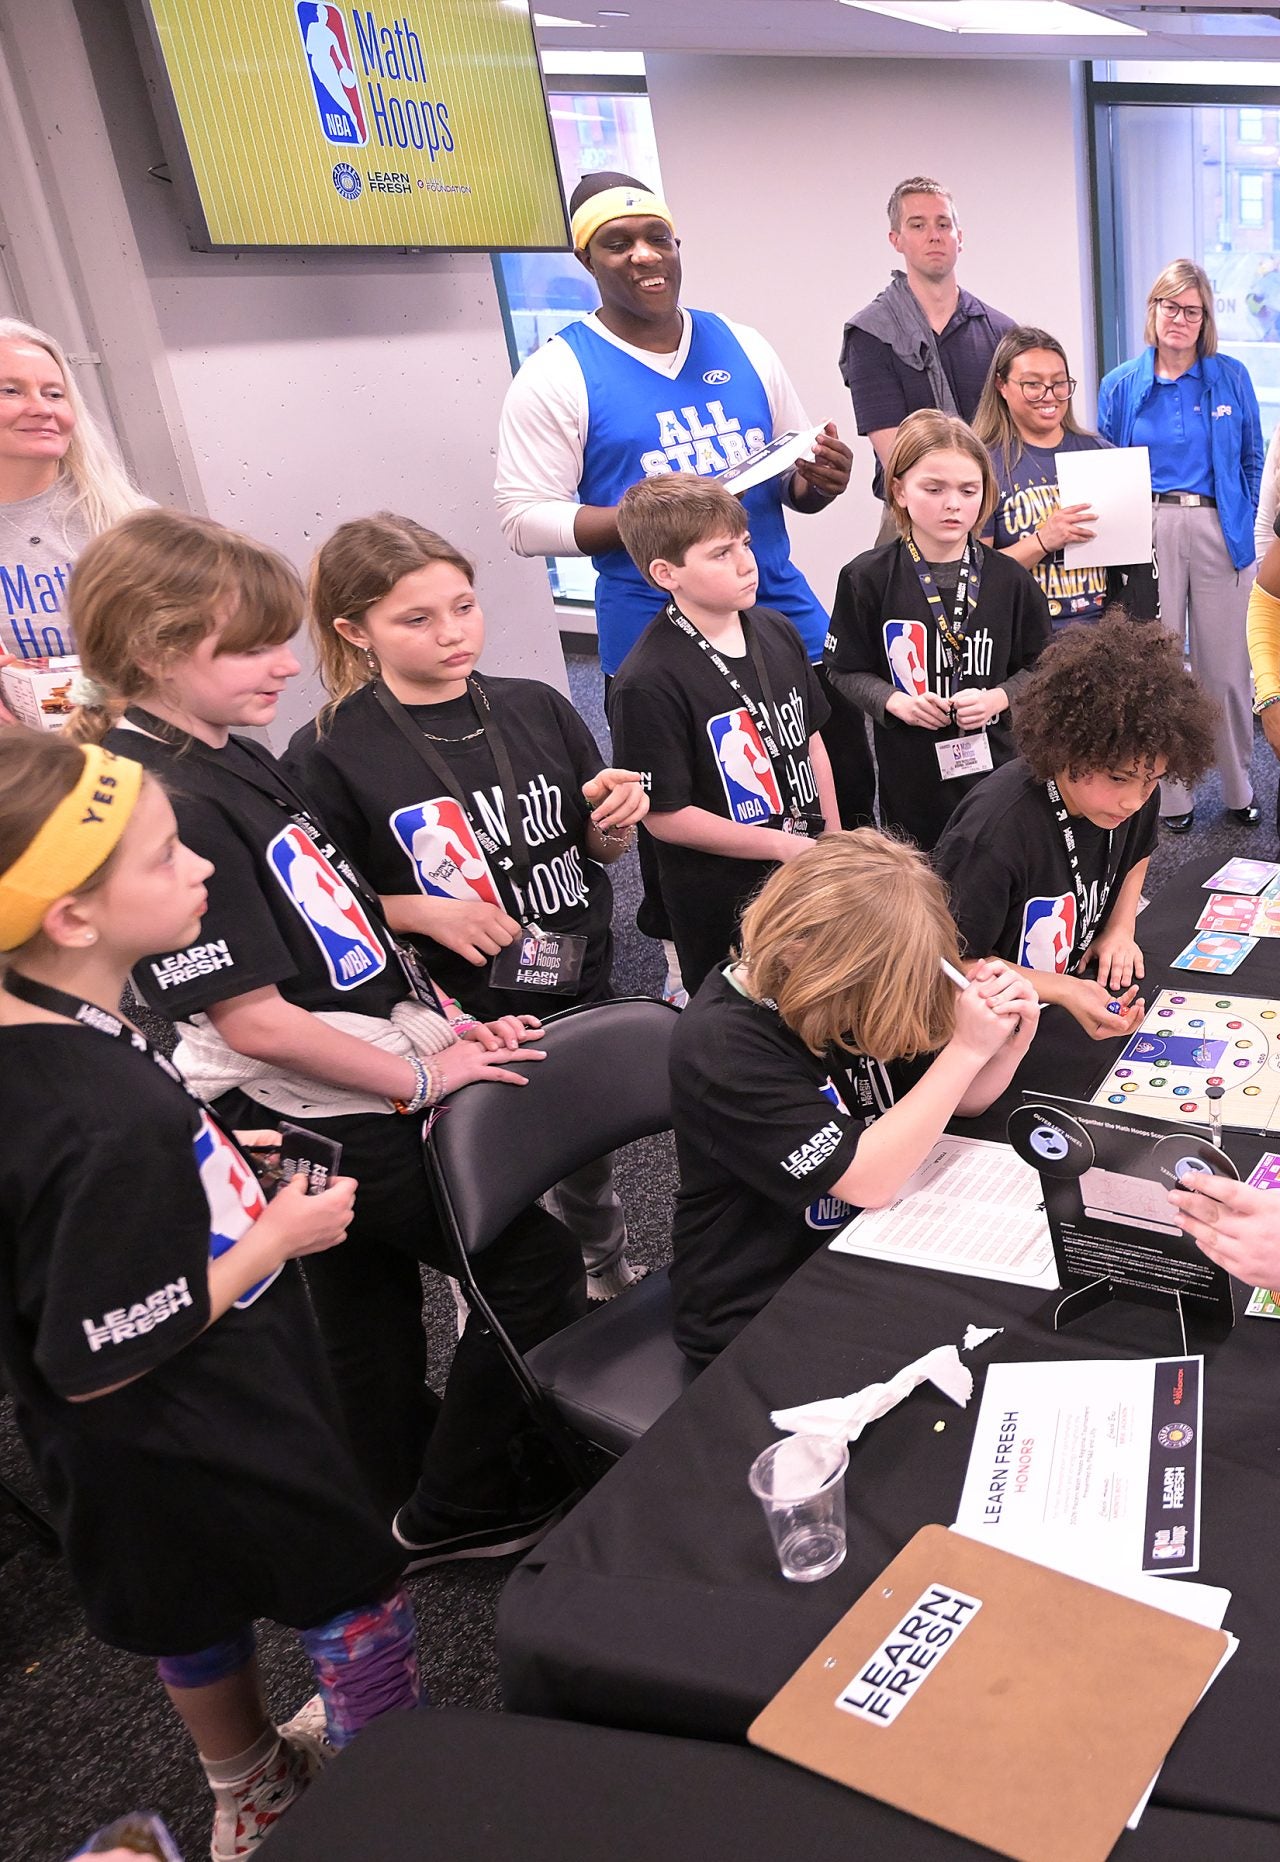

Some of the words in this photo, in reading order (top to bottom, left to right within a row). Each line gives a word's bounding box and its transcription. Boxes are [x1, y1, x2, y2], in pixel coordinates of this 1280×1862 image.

[352, 9, 427, 84] Math
[325, 113, 353, 139] NBA
[368, 82, 454, 162] Hoops
[367, 171, 410, 184] LEARN
[369, 182, 412, 194] FRESH
[426, 184, 472, 194] FOUNDATION
[655, 400, 741, 447] ALL
[640, 427, 767, 477] STARS
[0, 562, 73, 616] Mat
[81, 775, 118, 826] YES
[736, 797, 765, 821] NBA
[150, 939, 229, 978] LEARN
[339, 944, 372, 981] NBA
[536, 953, 561, 970] Hoops
[539, 939, 559, 955] Math
[156, 952, 235, 991] FRESH
[516, 976, 558, 987] FRESH
[517, 968, 559, 980] LEARN
[780, 1120, 840, 1173] LEARN
[1033, 1113, 1052, 1128] OUTER
[1050, 1123, 1065, 1135] LEFT
[1064, 1132, 1084, 1148] WHEEL
[1102, 1121, 1115, 1130] the
[1115, 1124, 1131, 1133] Math
[1131, 1127, 1151, 1137] Hoops
[789, 1130, 843, 1180] FRESH
[818, 1198, 850, 1220] NBA
[82, 1276, 189, 1335] LEARN
[86, 1291, 194, 1353] FRESH
[992, 1410, 1019, 1466] FRESH
[1014, 1437, 1035, 1494] HONORS
[982, 1467, 1008, 1526] LEARN
[1162, 1466, 1176, 1509] LEARN
[1172, 1466, 1186, 1509] FRESH
[843, 1589, 950, 1709] LEARN
[867, 1599, 975, 1720] FRESH
